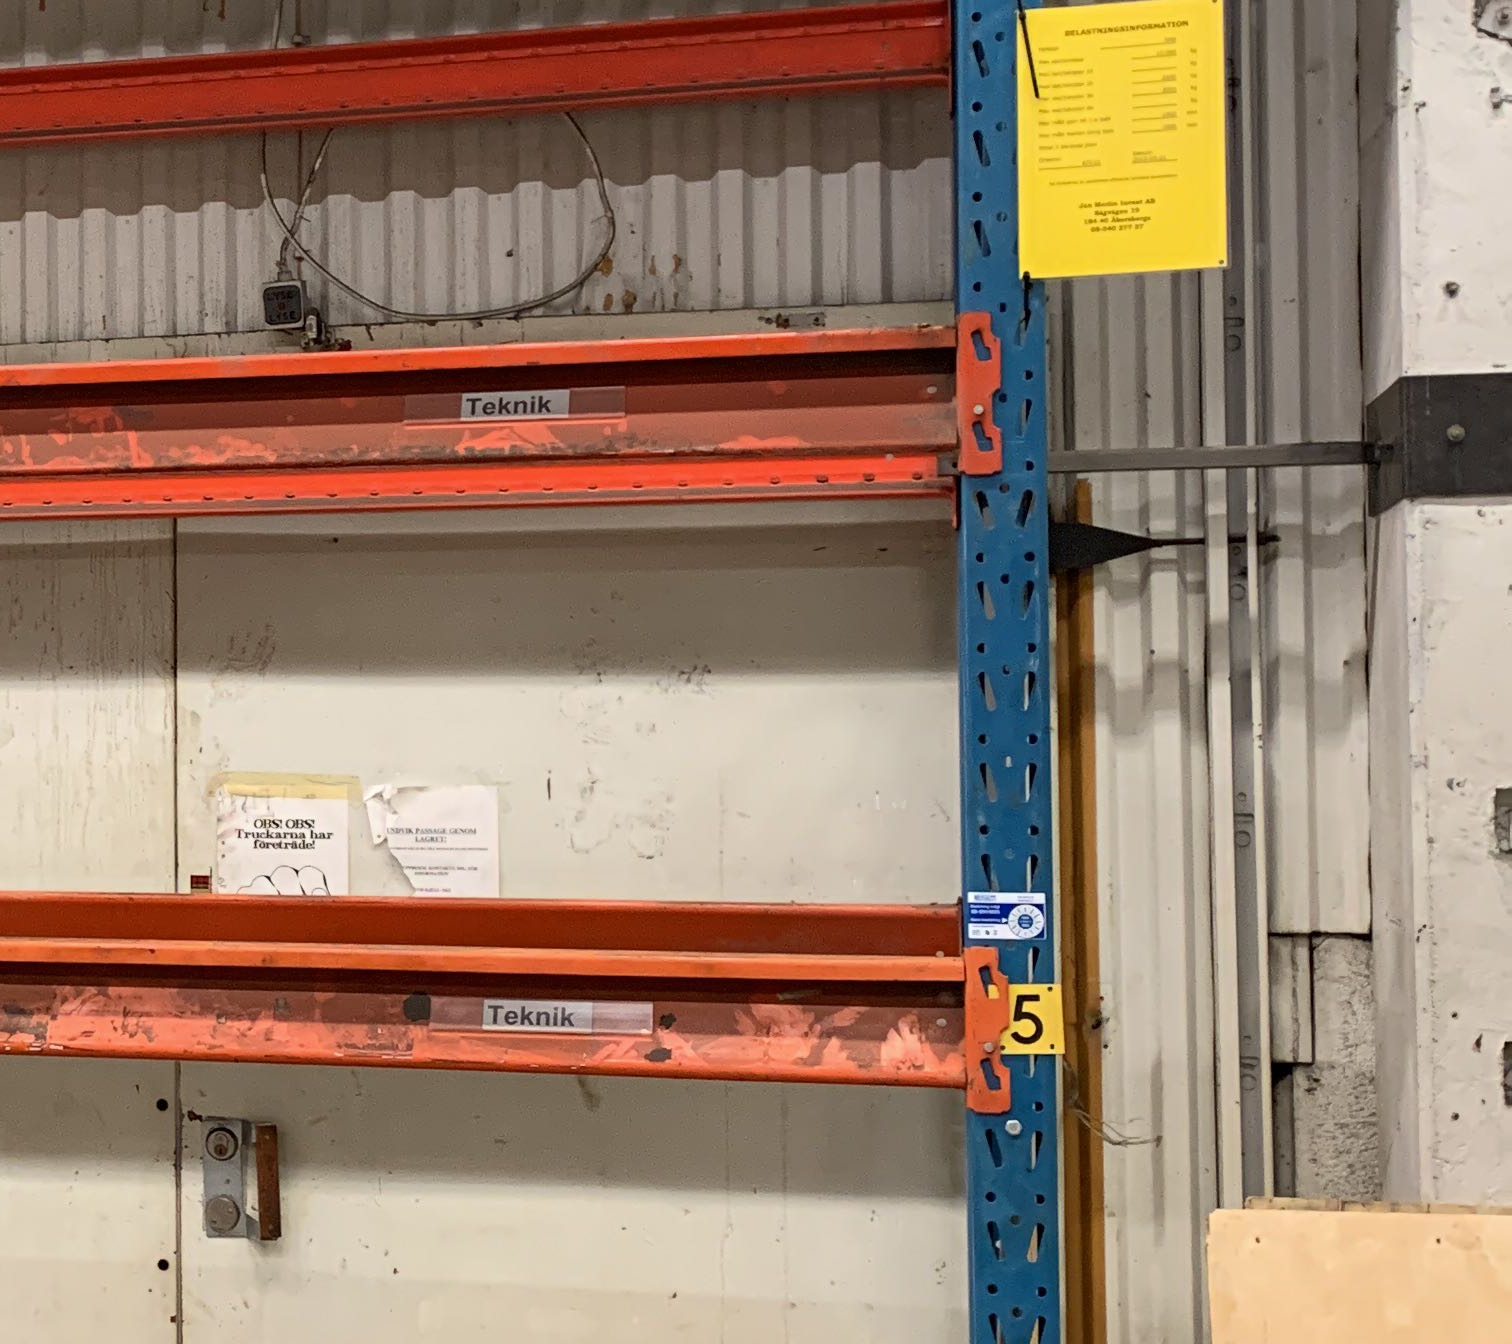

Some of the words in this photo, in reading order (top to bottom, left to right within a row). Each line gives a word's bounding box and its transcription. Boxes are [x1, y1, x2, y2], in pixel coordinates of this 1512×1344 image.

[1064, 20, 1189, 36] BELASTNINGSINFORMATION
[466, 395, 554, 416] Teknik
[253, 818, 283, 829] OBS!
[285, 818, 316, 829] OBS!
[235, 828, 307, 839] Truckarna
[310, 829, 334, 839] har
[253, 839, 316, 850] företräde!
[488, 1004, 576, 1029] Teknik
[1010, 994, 1044, 1045] 5
